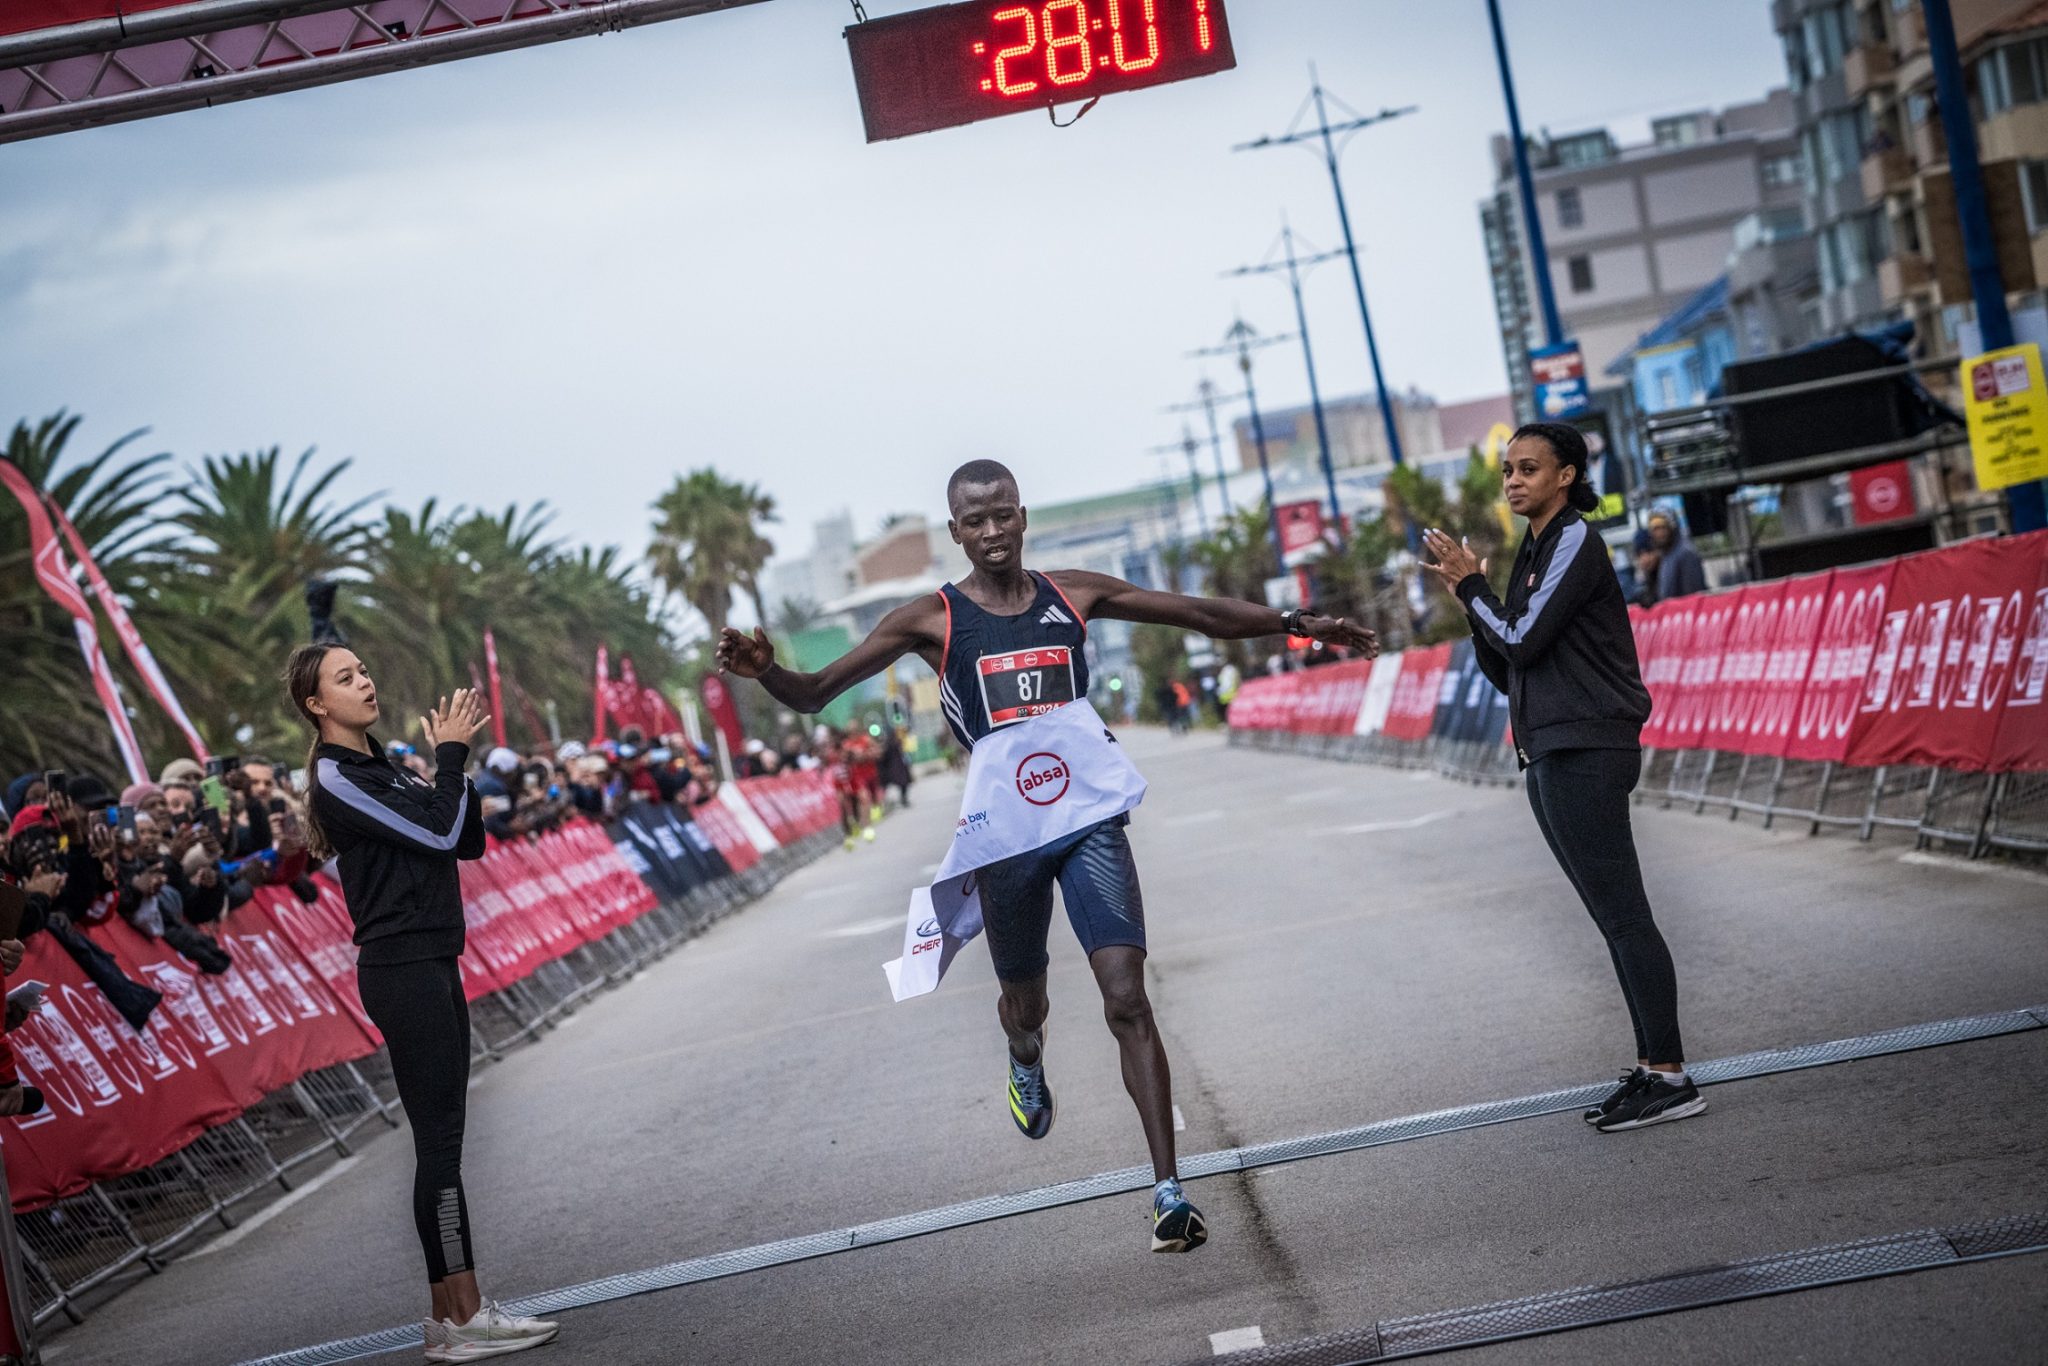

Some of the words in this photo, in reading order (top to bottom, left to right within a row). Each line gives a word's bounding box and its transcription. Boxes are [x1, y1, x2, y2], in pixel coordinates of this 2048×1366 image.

[1017, 670, 1042, 701] 87
[1023, 766, 1063, 791] absa
[968, 810, 987, 823] bay
[912, 937, 942, 955] CHER
